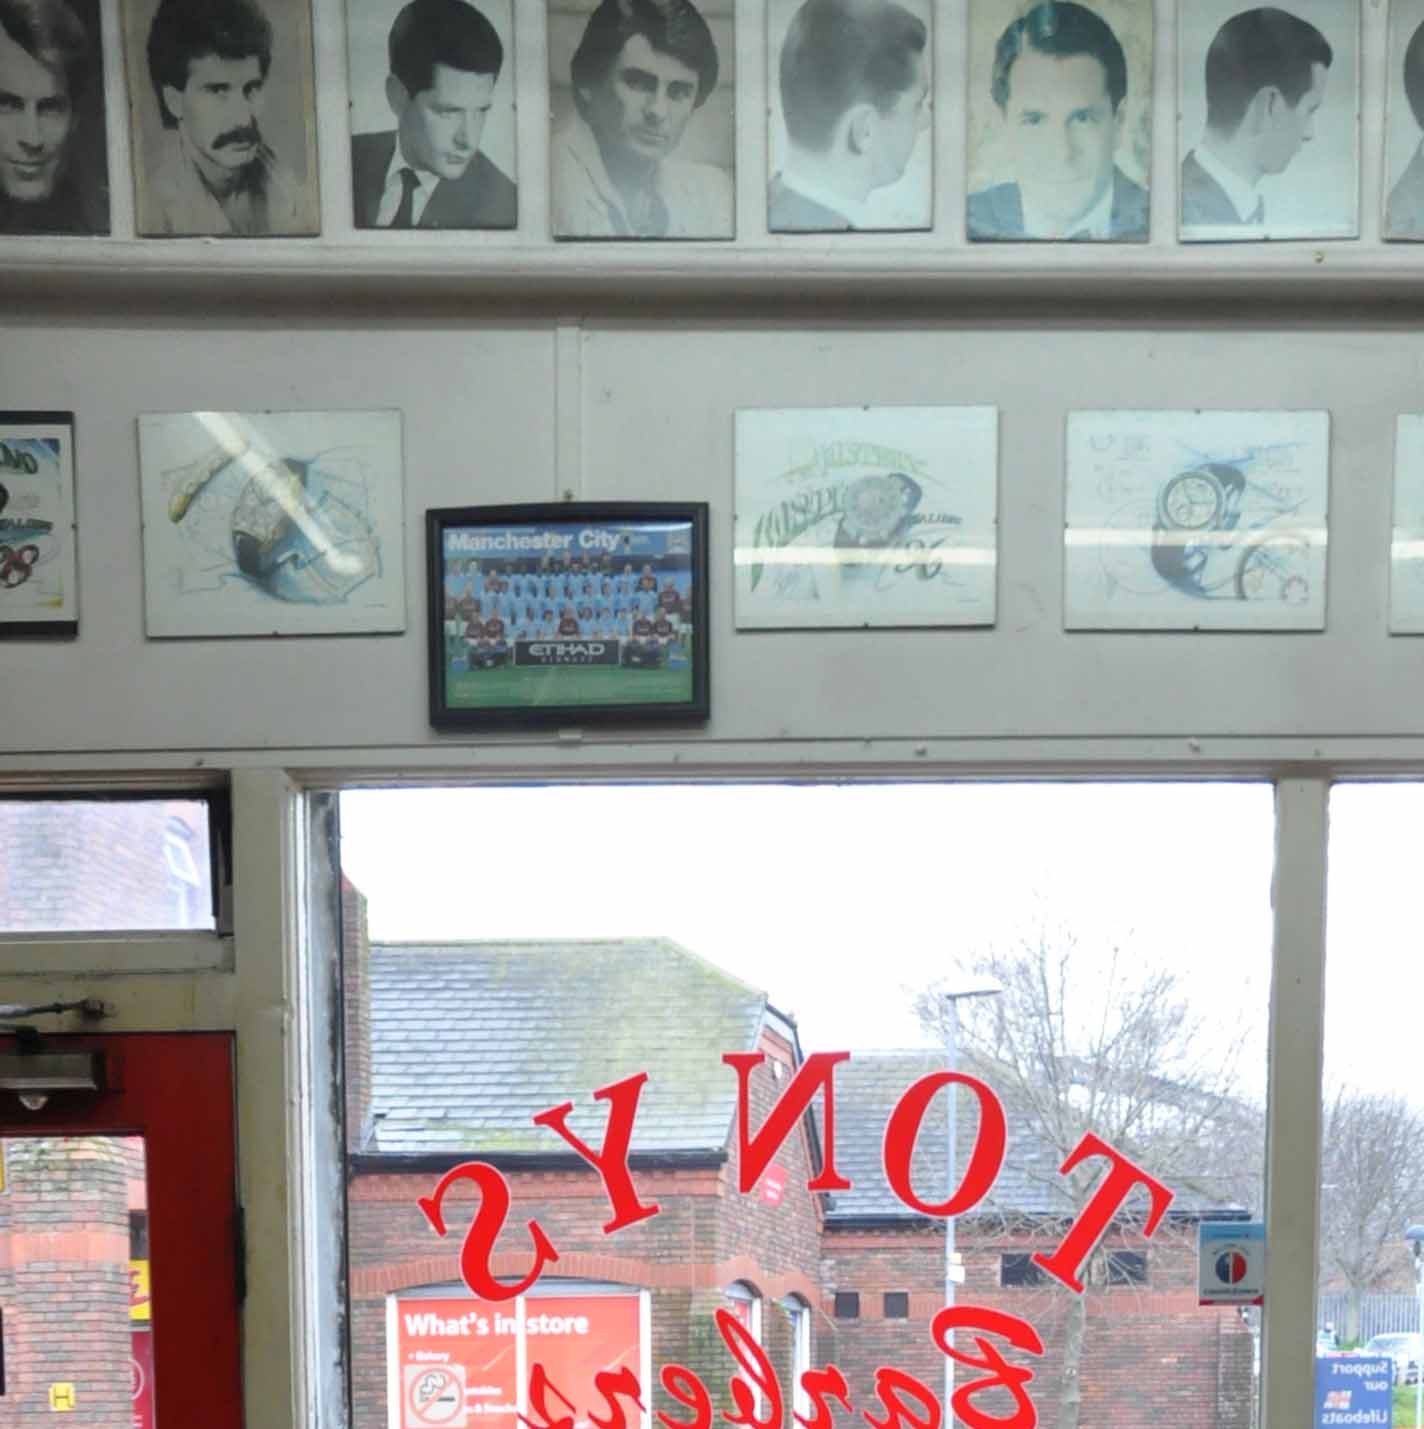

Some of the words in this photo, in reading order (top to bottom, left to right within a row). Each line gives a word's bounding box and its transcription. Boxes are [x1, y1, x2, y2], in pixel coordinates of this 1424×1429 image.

[447, 532, 573, 551] Manchester
[578, 529, 620, 552] City
[529, 643, 605, 656] ETIHAD
[404, 1311, 489, 1336] What's
[495, 1313, 517, 1335] in
[526, 1315, 589, 1334] store
